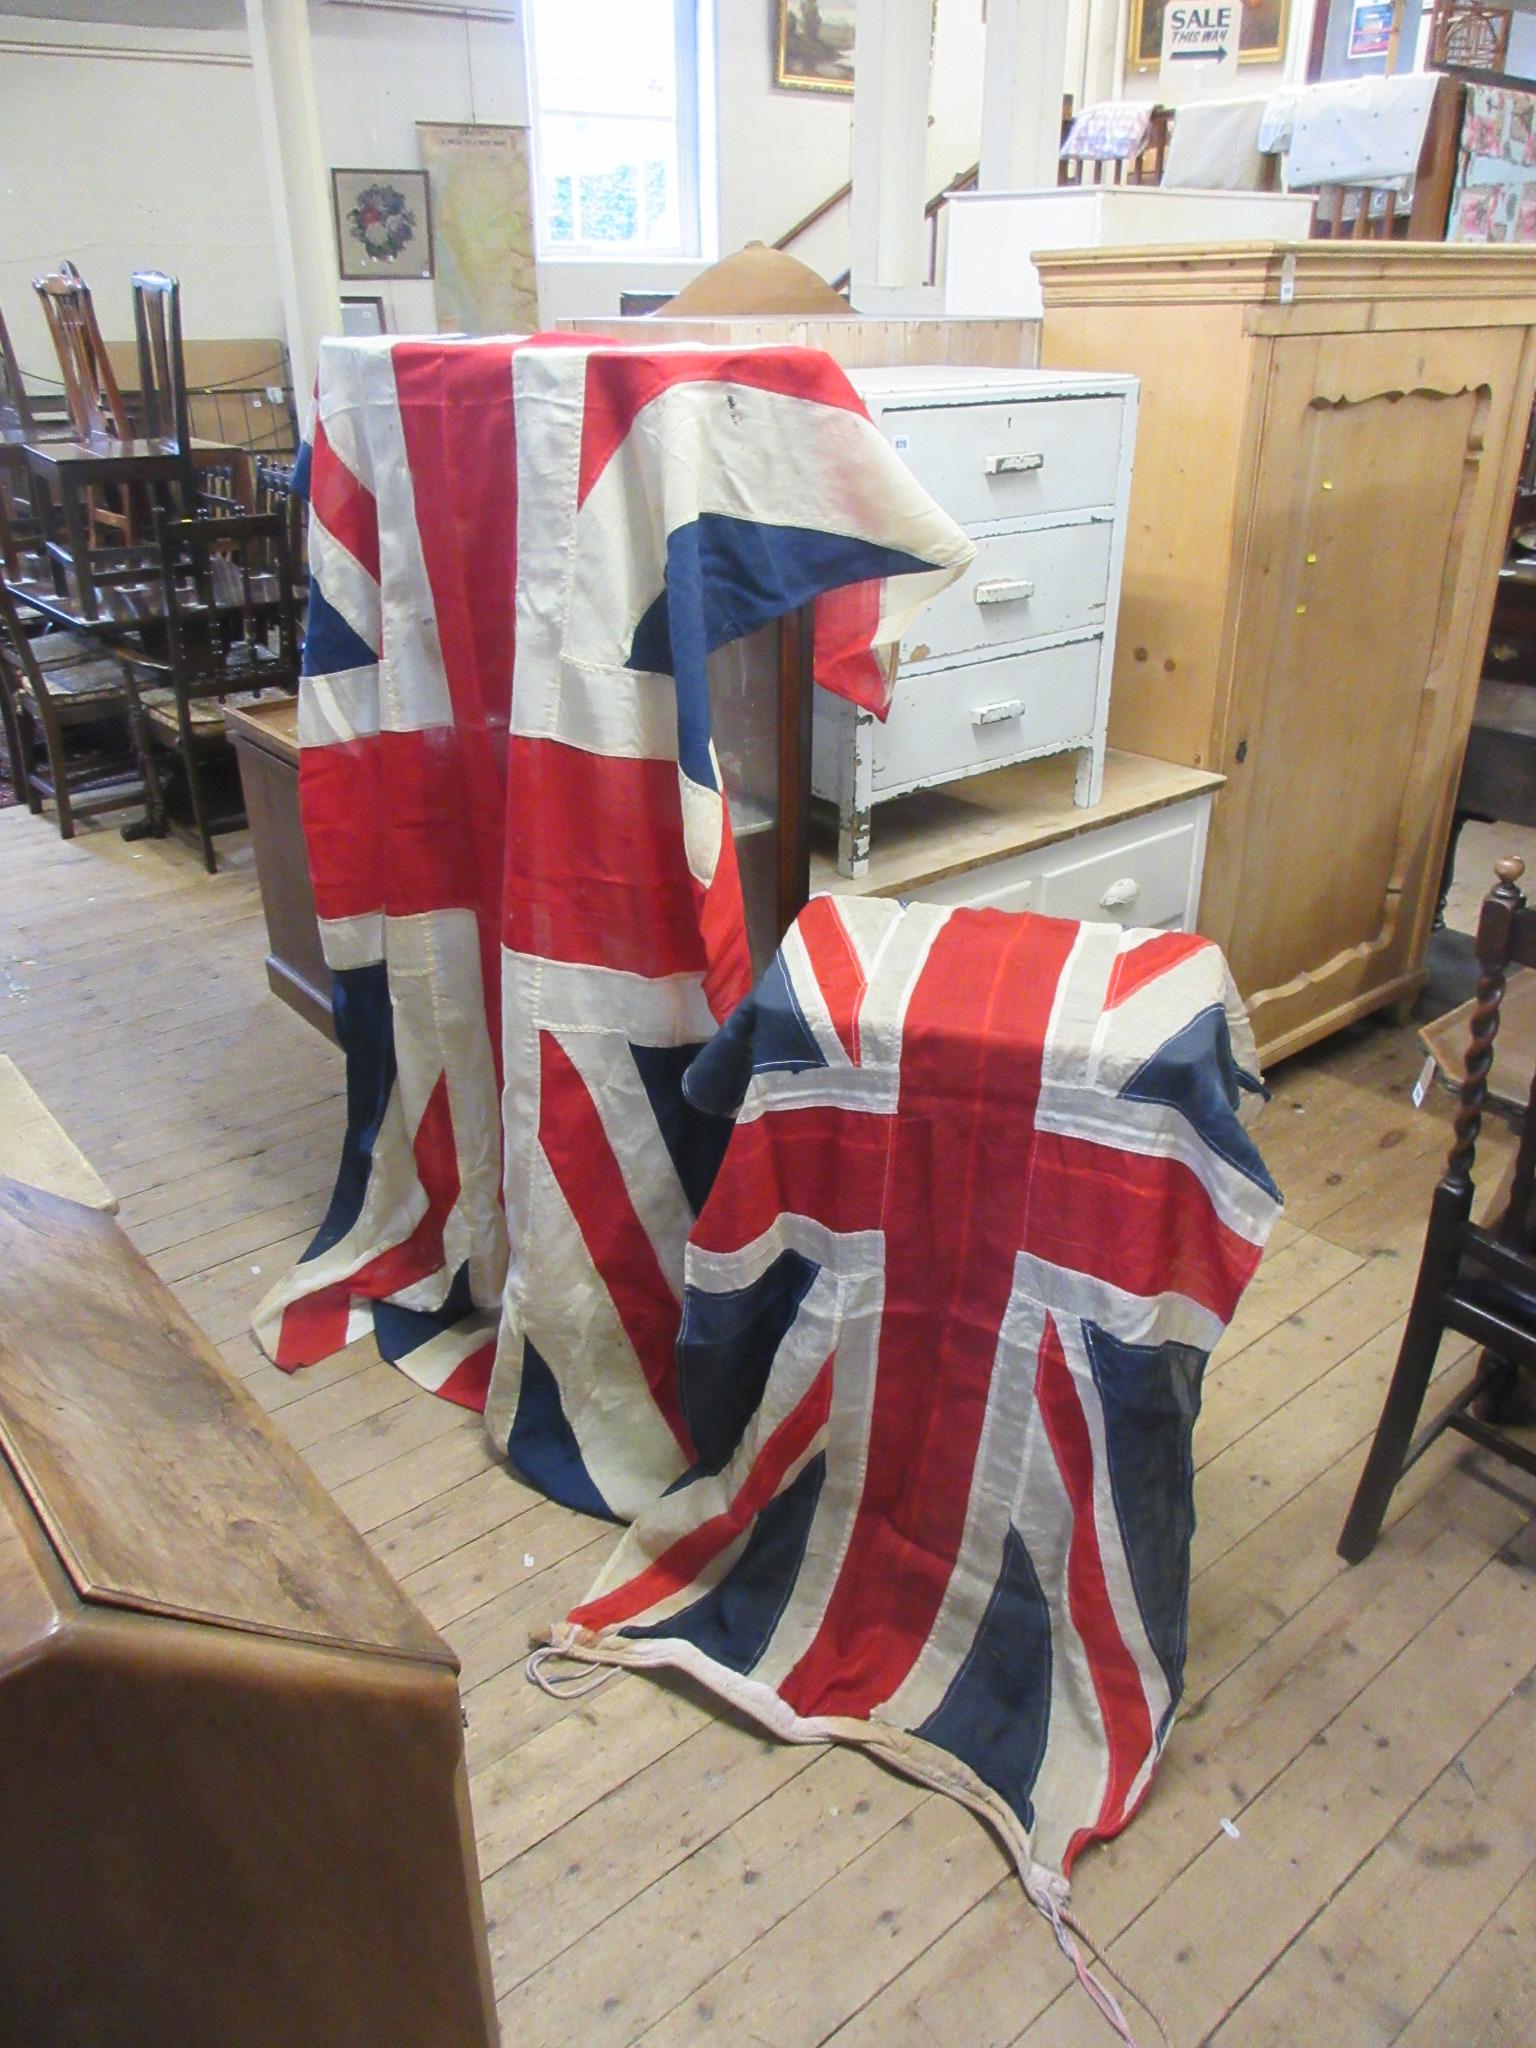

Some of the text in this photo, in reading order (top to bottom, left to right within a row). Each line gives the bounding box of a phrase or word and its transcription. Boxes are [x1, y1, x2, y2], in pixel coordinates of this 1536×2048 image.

[1171, 8, 1232, 30] SALE
[1171, 29, 1228, 43] THIS WAY
